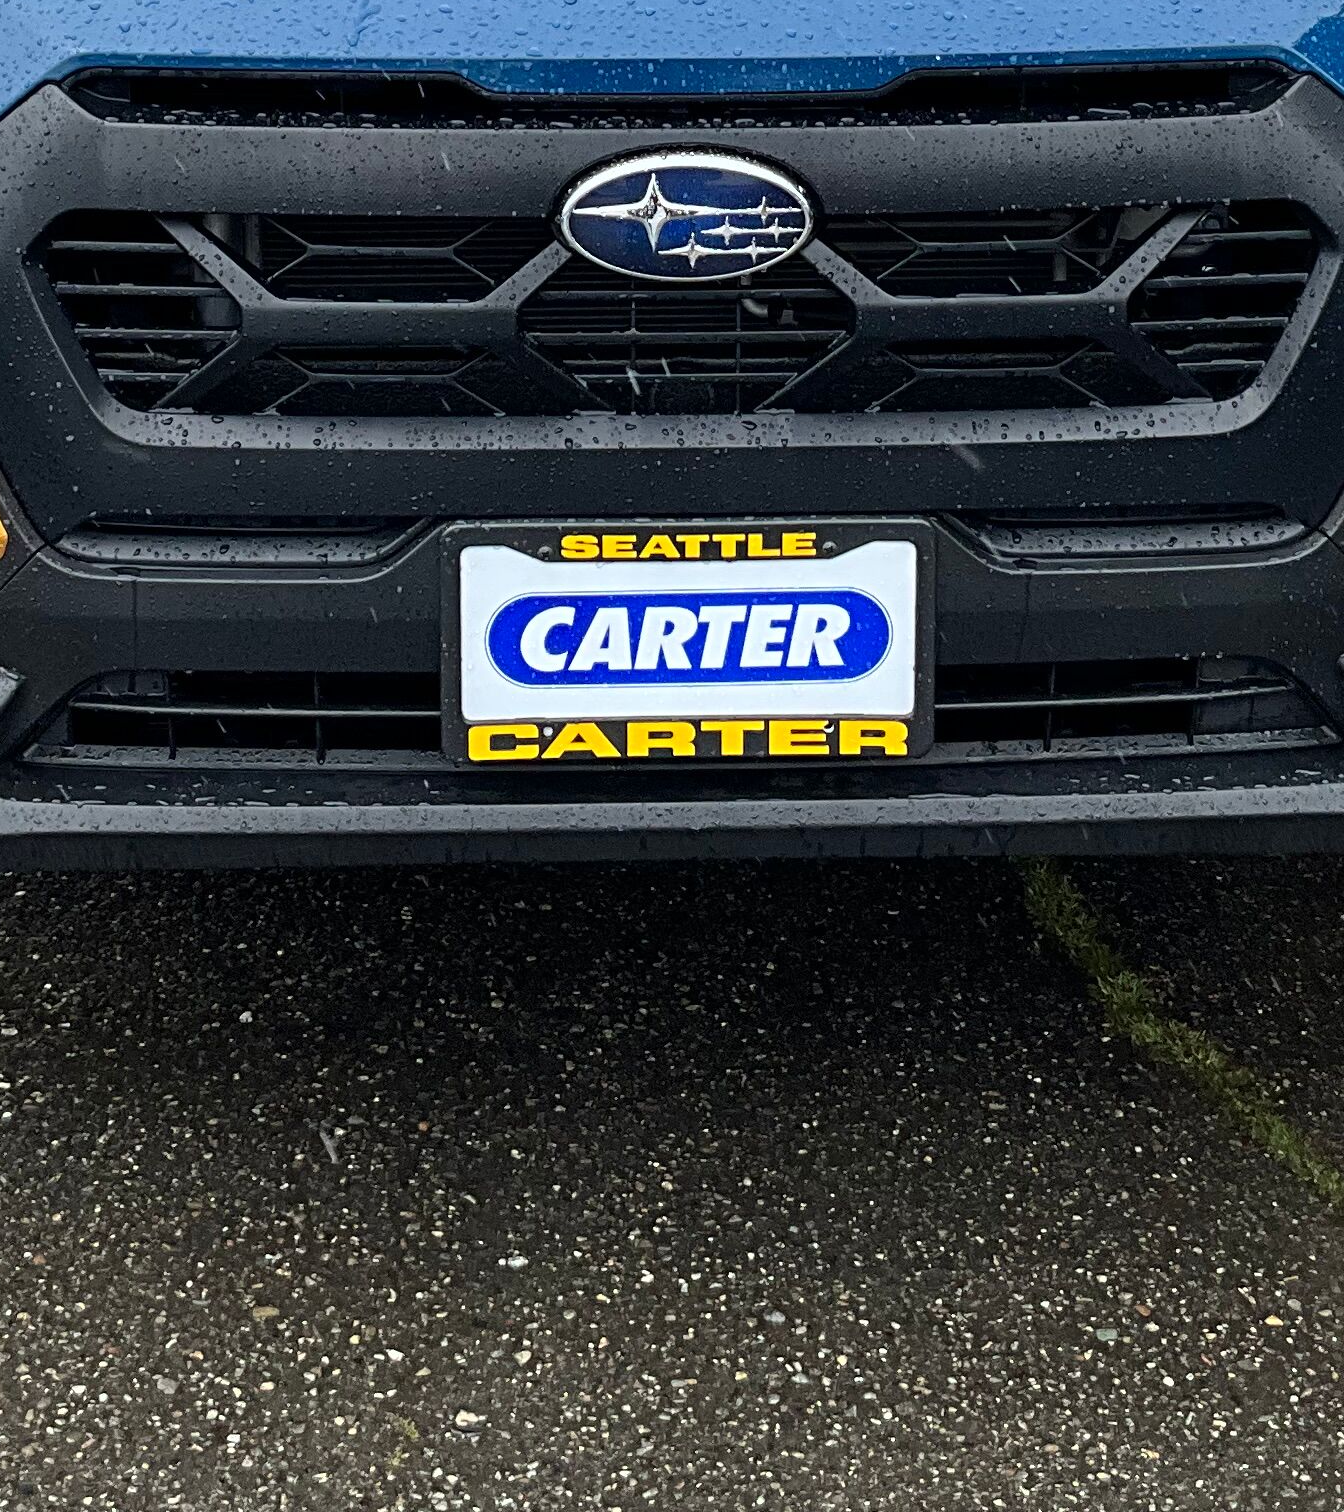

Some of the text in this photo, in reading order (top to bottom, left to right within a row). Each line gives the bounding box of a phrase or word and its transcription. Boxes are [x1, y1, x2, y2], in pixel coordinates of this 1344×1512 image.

[561, 533, 817, 559] SEATTLE
[519, 603, 851, 672] CARTER
[467, 720, 909, 761] CARTER
